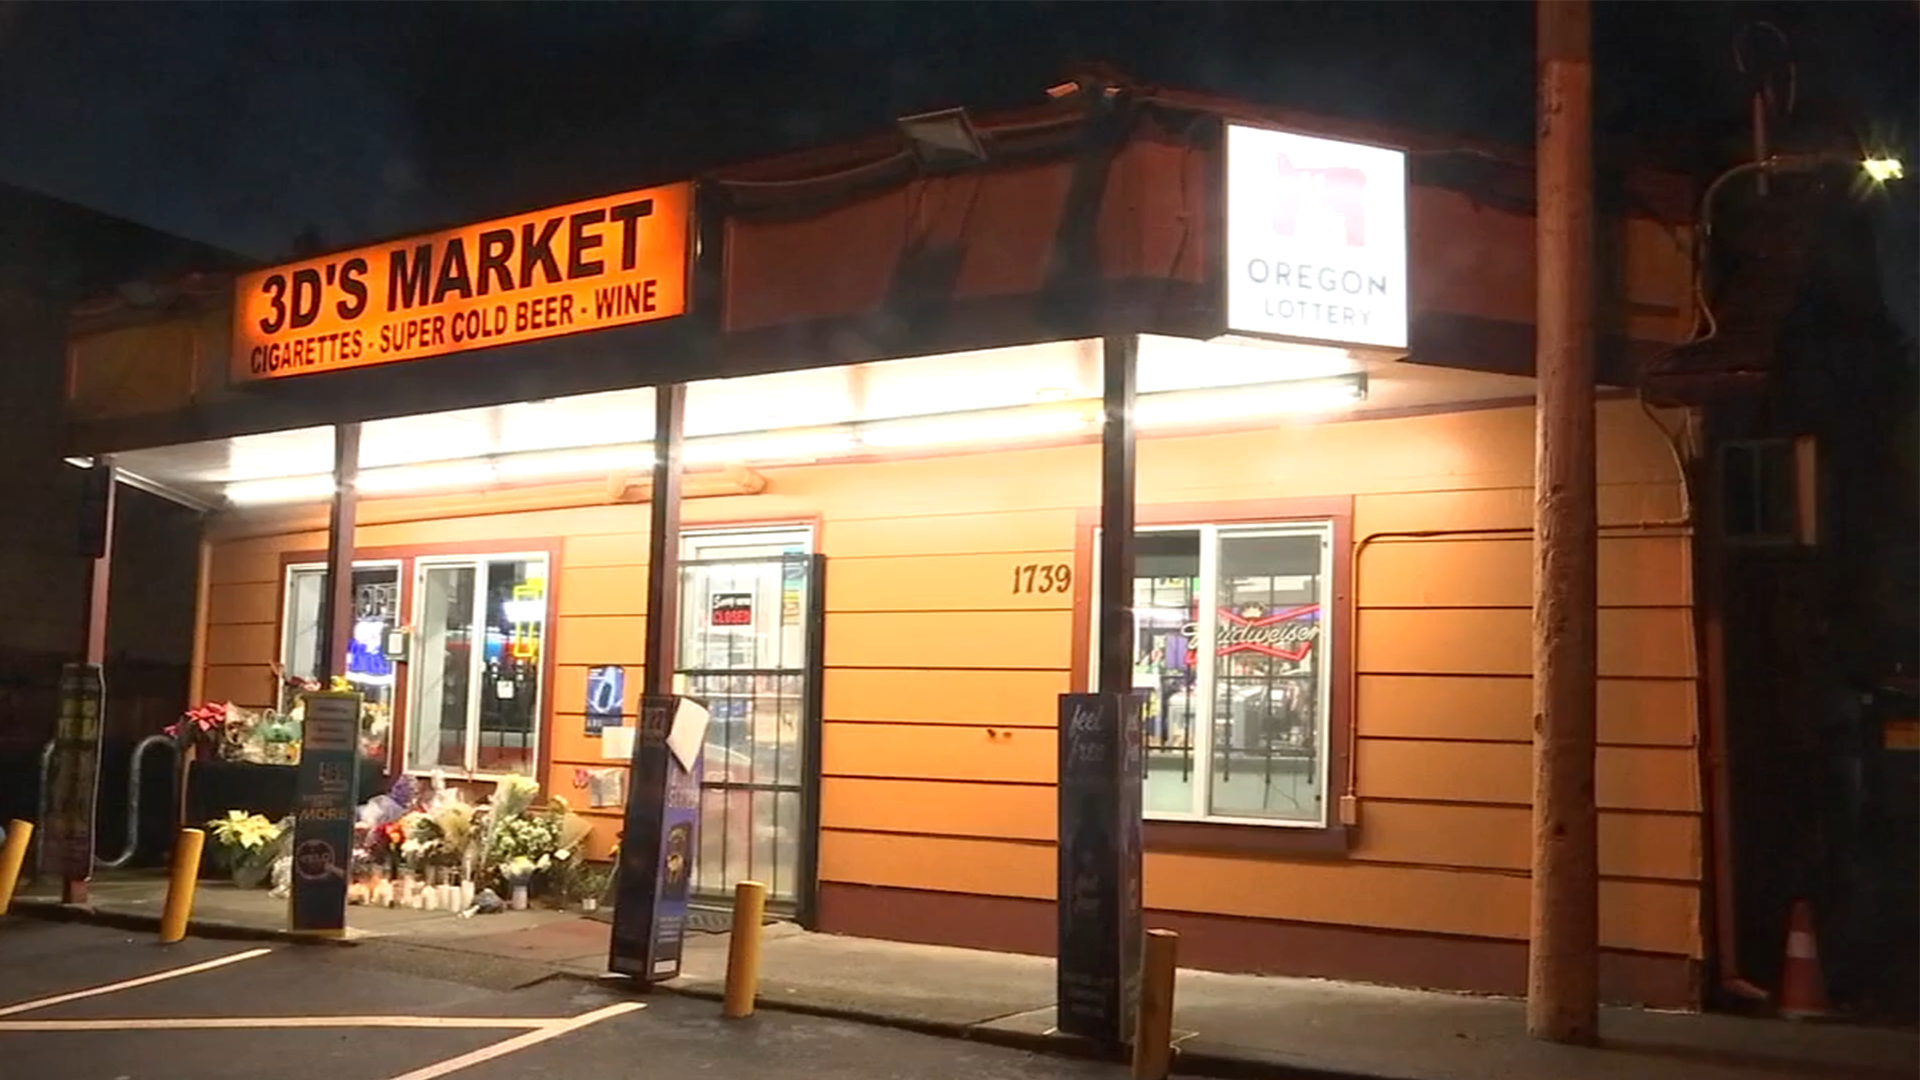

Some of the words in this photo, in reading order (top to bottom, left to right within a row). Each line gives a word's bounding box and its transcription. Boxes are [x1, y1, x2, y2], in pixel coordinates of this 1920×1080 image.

[259, 257, 368, 335] 3D'S
[387, 199, 654, 312] MARKET
[1247, 258, 1387, 296] OREGON
[251, 332, 363, 375] CIGARETTES
[380, 317, 445, 353] SUPER
[451, 305, 507, 341] COLD
[515, 293, 574, 332] BEER
[595, 279, 658, 320] WINE
[1265, 299, 1372, 326] LOTTERY
[1012, 563, 1072, 595] 1739
[713, 609, 751, 624] CLOSED
